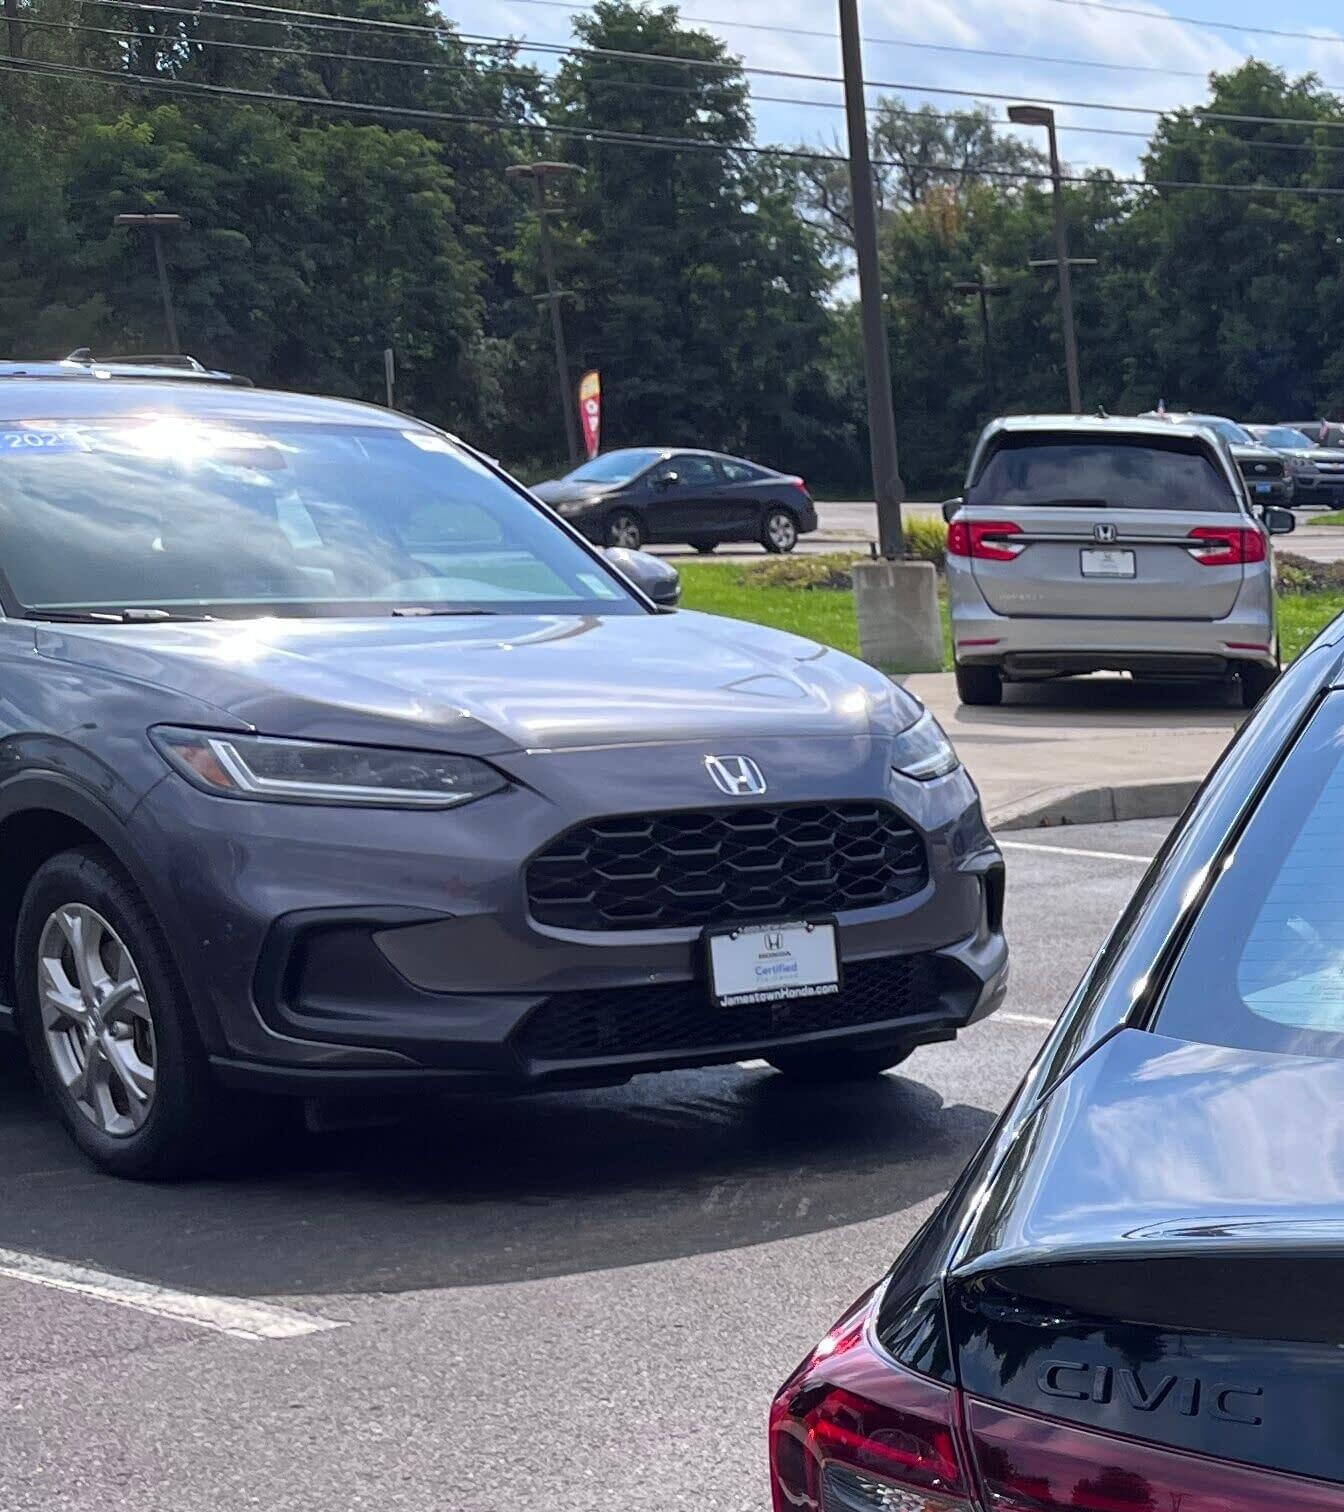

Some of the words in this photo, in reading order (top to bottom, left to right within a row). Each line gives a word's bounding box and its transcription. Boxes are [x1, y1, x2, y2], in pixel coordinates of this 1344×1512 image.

[755, 960, 798, 976] Certified
[719, 984, 839, 1007] JamestownHonda.com
[1037, 1359, 1263, 1425] CIVIC
